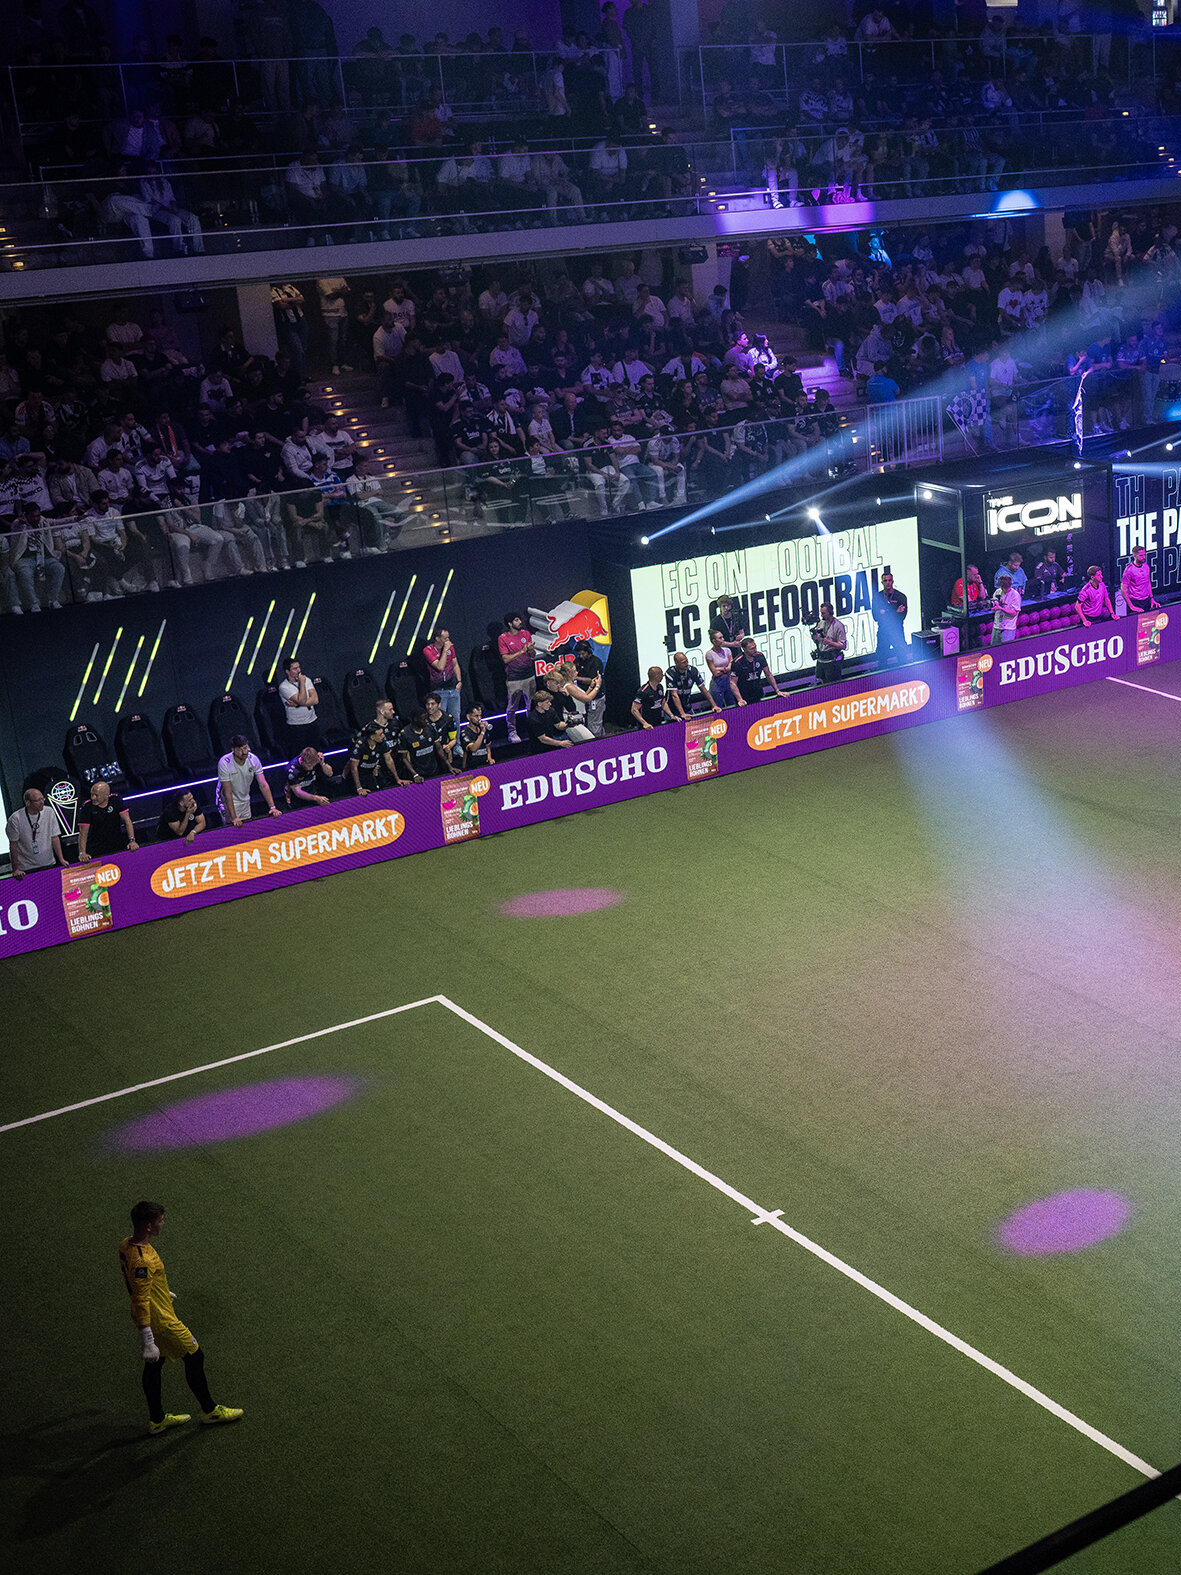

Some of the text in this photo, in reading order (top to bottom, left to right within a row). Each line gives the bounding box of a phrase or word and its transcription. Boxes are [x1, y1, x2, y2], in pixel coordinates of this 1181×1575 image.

[987, 493, 1082, 535] ICON
[1115, 474, 1145, 518] TH
[1116, 512, 1157, 557] THE
[661, 557, 699, 608] FC
[705, 549, 748, 599] ON
[1116, 550, 1159, 590] TE
[666, 604, 701, 652] FC
[999, 635, 1124, 686] EDUSCHO
[710, 723, 726, 736] NEU
[754, 685, 926, 746] JETZT IM SUPERMARKT
[470, 780, 489, 793] NEU
[499, 746, 668, 811] EDUSCHO
[162, 814, 398, 892] JETZT IM SUPERMARKT
[97, 868, 119, 883] NEU
[0, 899, 39, 936] O
[70, 911, 103, 926] LIEBLINGS
